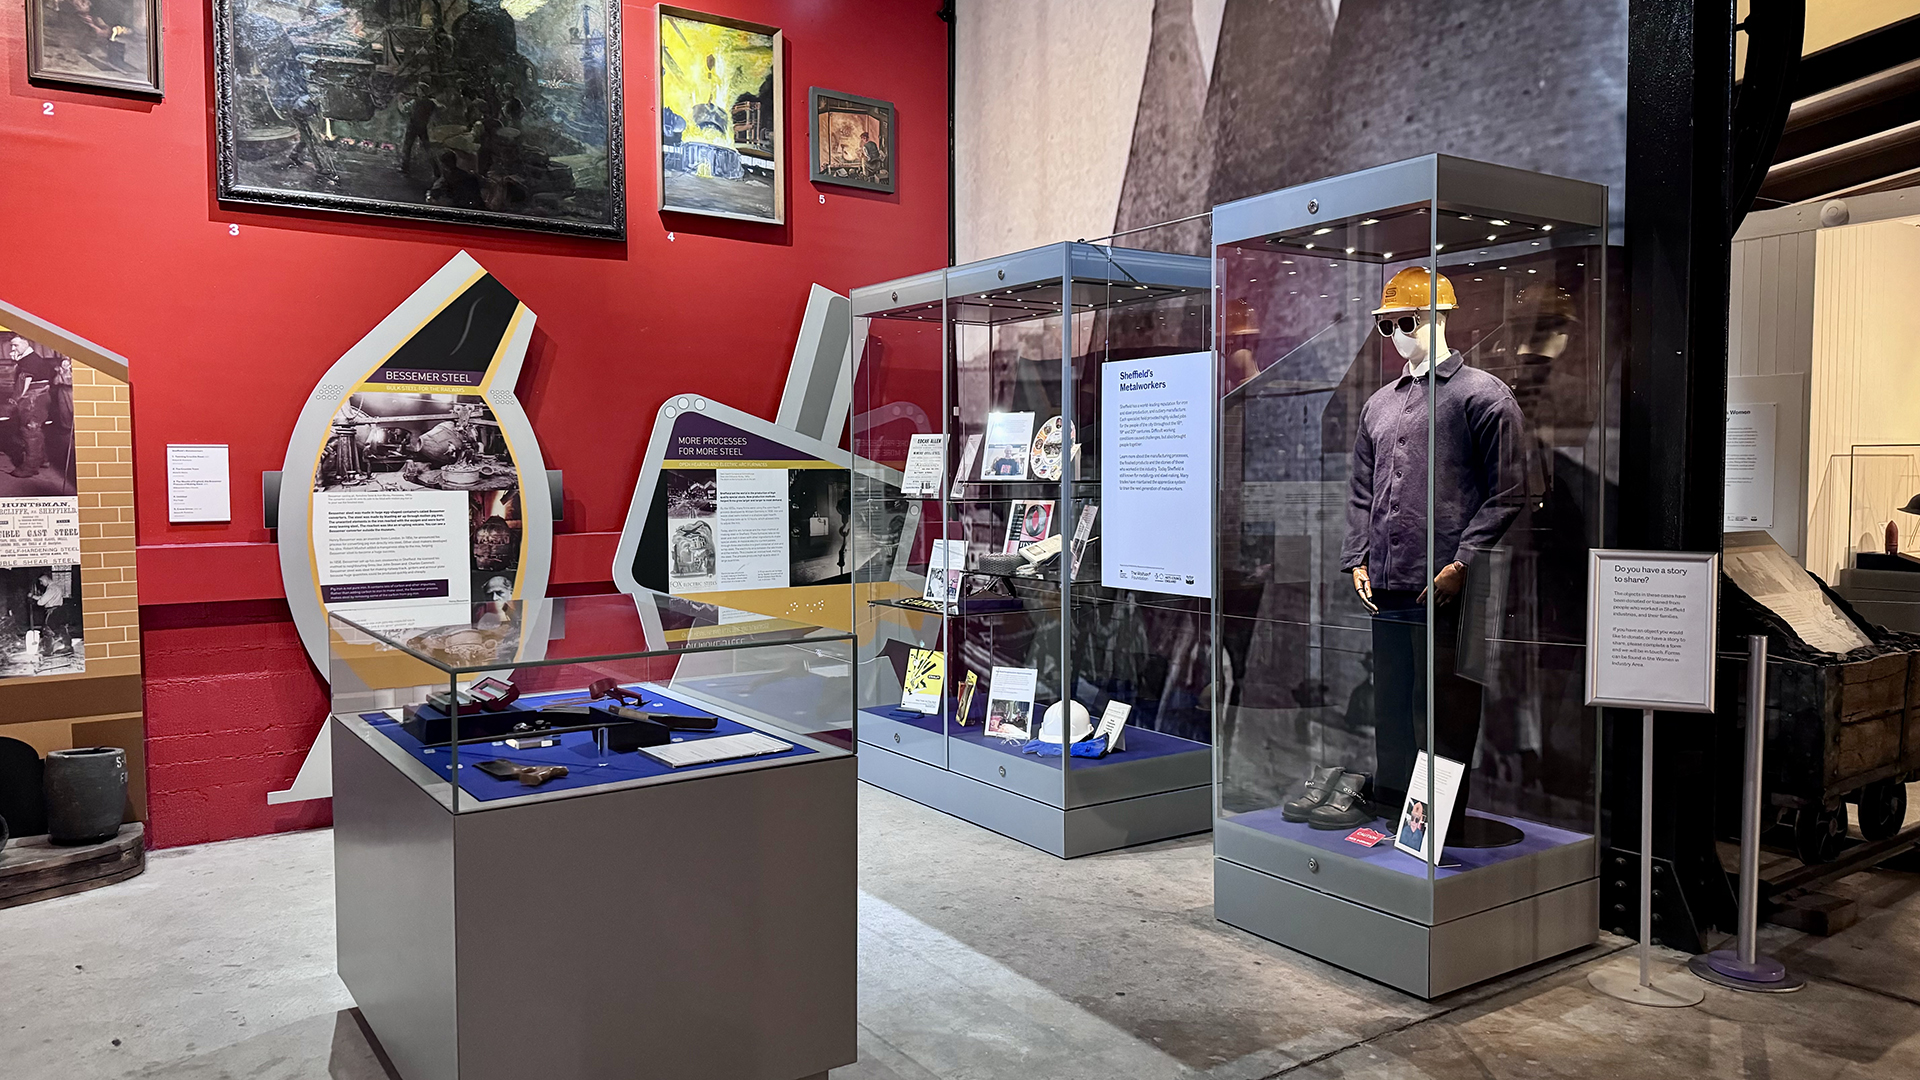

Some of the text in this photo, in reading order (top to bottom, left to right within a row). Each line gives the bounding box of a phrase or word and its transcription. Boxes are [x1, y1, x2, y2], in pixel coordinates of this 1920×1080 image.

[42, 103, 54, 115] 2
[819, 195, 825, 204] 5
[228, 224, 239, 235] 3
[667, 232, 675, 241] 4
[386, 371, 471, 383] BESSEMER STEEL
[1120, 369, 1153, 380] Sheffield's
[1120, 381, 1166, 392] Metalworkers
[703, 437, 747, 445] PROCESSES
[1667, 566, 1687, 576] story
